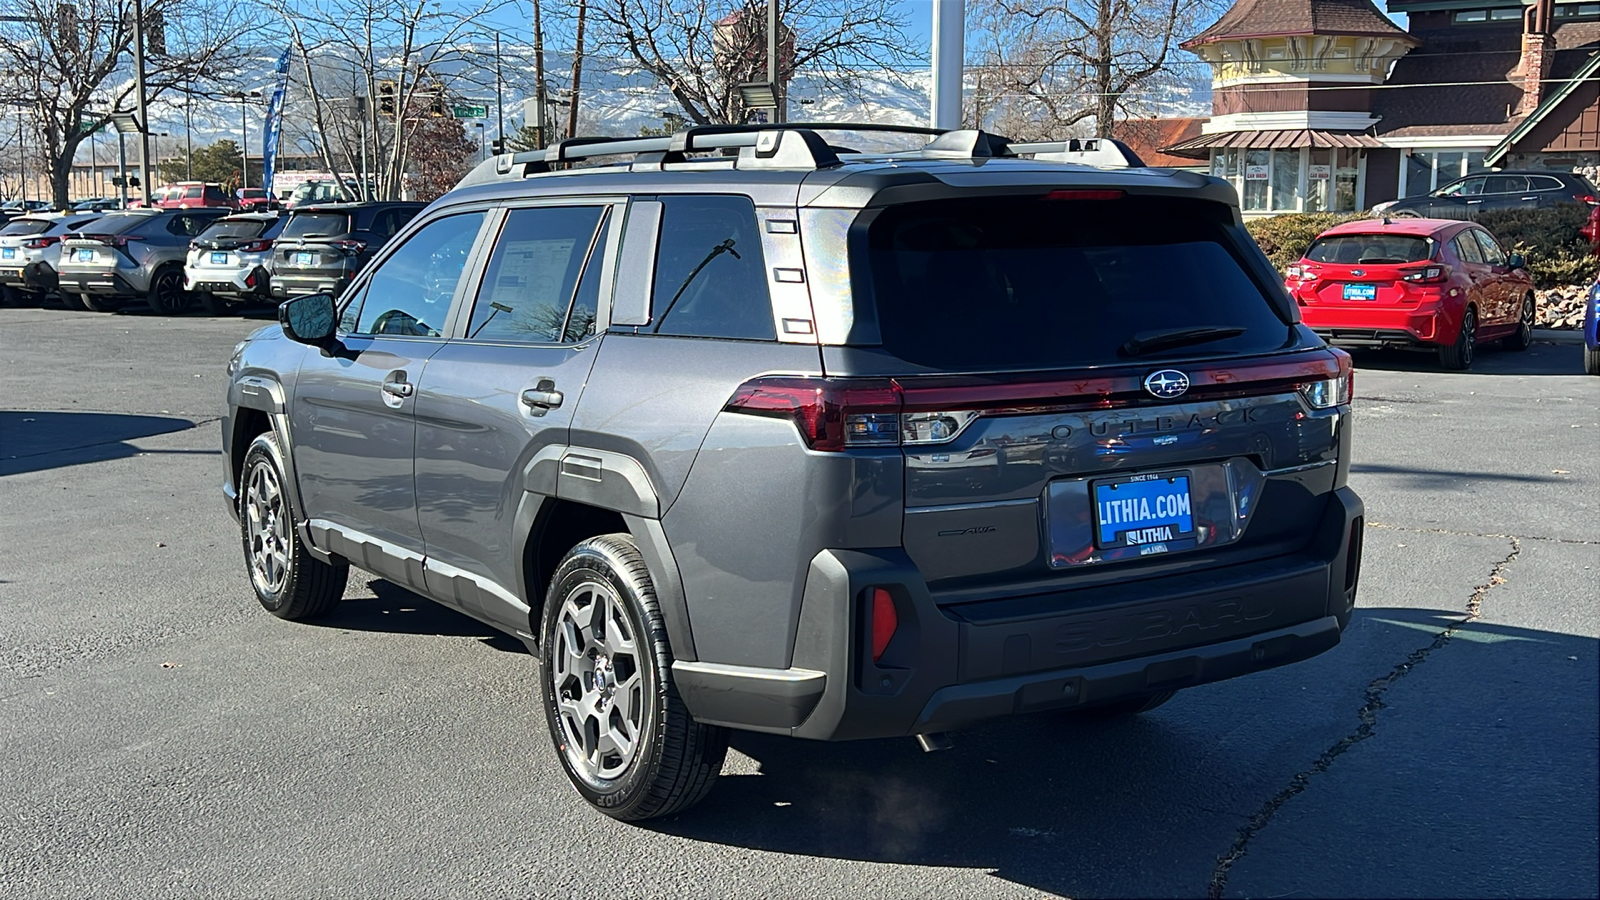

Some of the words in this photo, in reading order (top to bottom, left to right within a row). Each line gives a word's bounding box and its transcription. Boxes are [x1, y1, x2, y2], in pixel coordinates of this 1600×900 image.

[1051, 407, 1257, 440] OUTBACK
[1130, 475, 1146, 483] SINCE
[1098, 492, 1191, 526] LITHIA.COM
[1137, 526, 1173, 544] LITHIA
[1056, 595, 1273, 652] SUBARU
